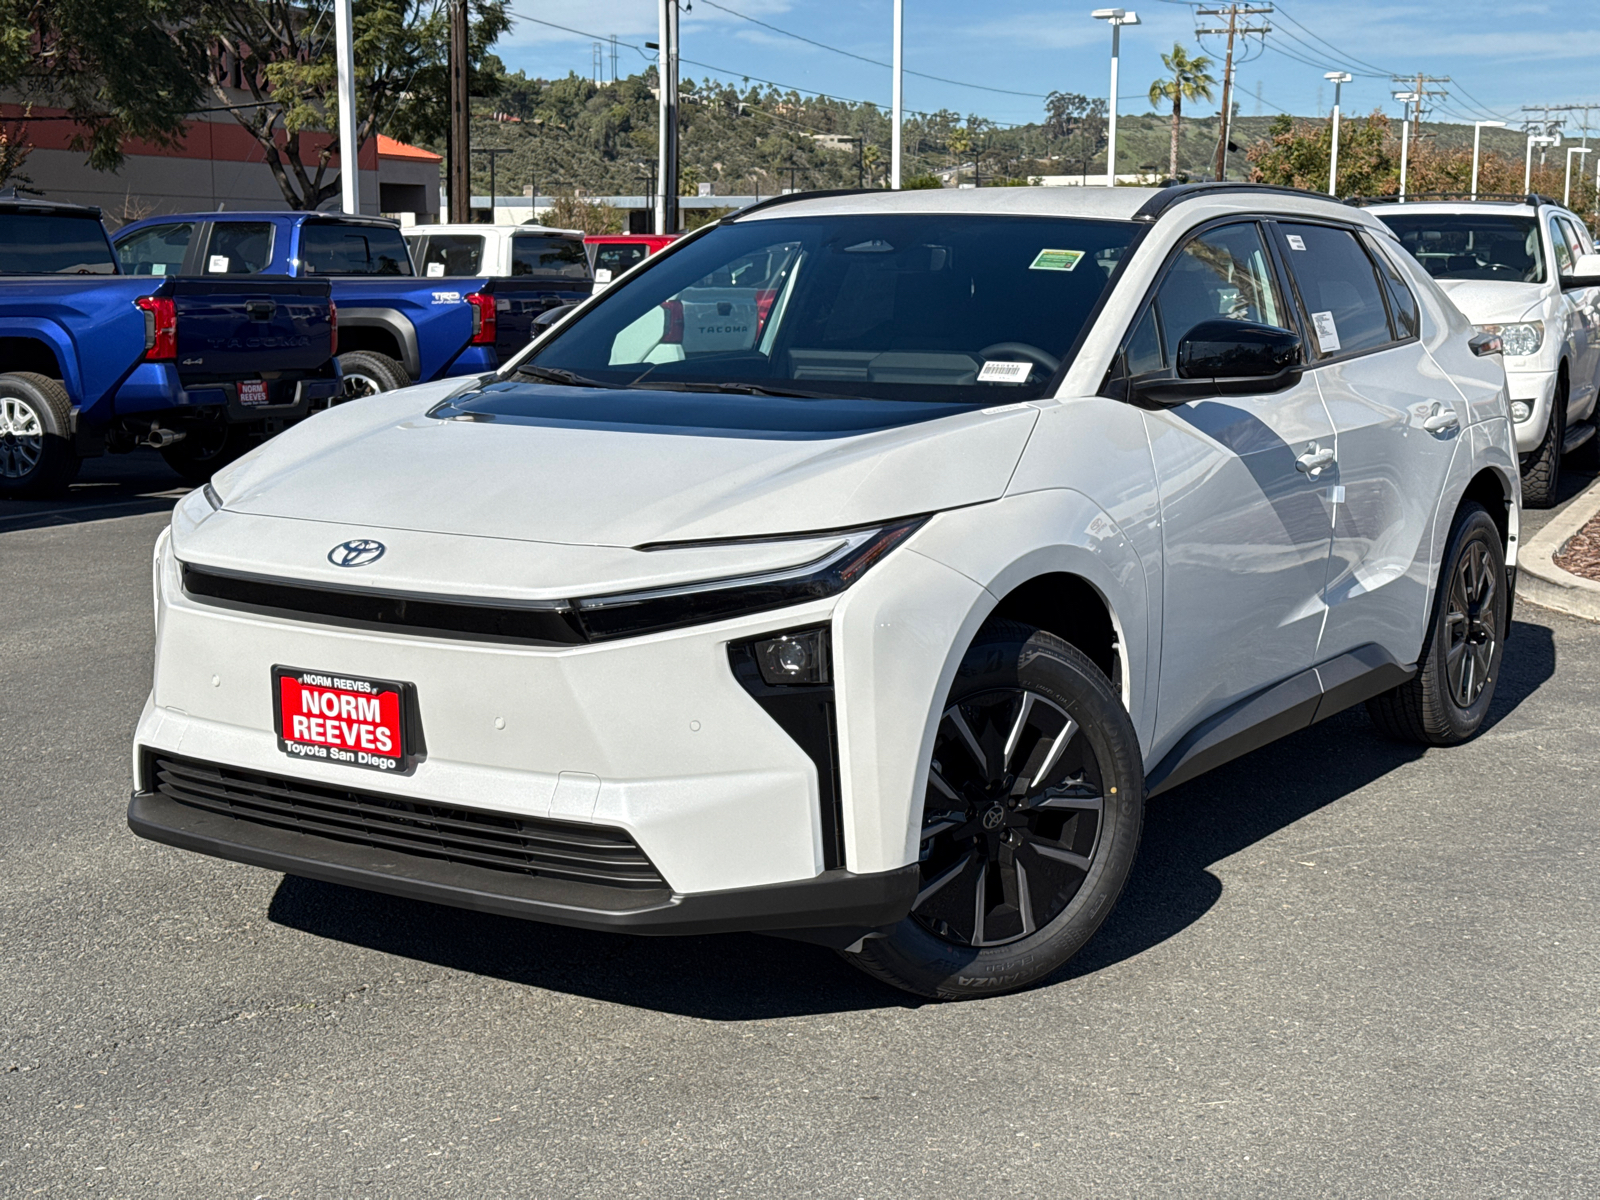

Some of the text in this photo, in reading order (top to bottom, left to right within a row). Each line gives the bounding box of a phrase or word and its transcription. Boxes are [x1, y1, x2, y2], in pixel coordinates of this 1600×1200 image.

[431, 291, 460, 301] TRD
[698, 326, 748, 334] TACOMA
[207, 335, 312, 349] TACOMA
[242, 385, 263, 393] NORM
[240, 392, 266, 401] REEVES
[303, 674, 371, 693] NORM REEVES
[301, 689, 381, 723] NORM
[292, 715, 392, 752] REEVES
[285, 740, 396, 770] Toyota San Diego
